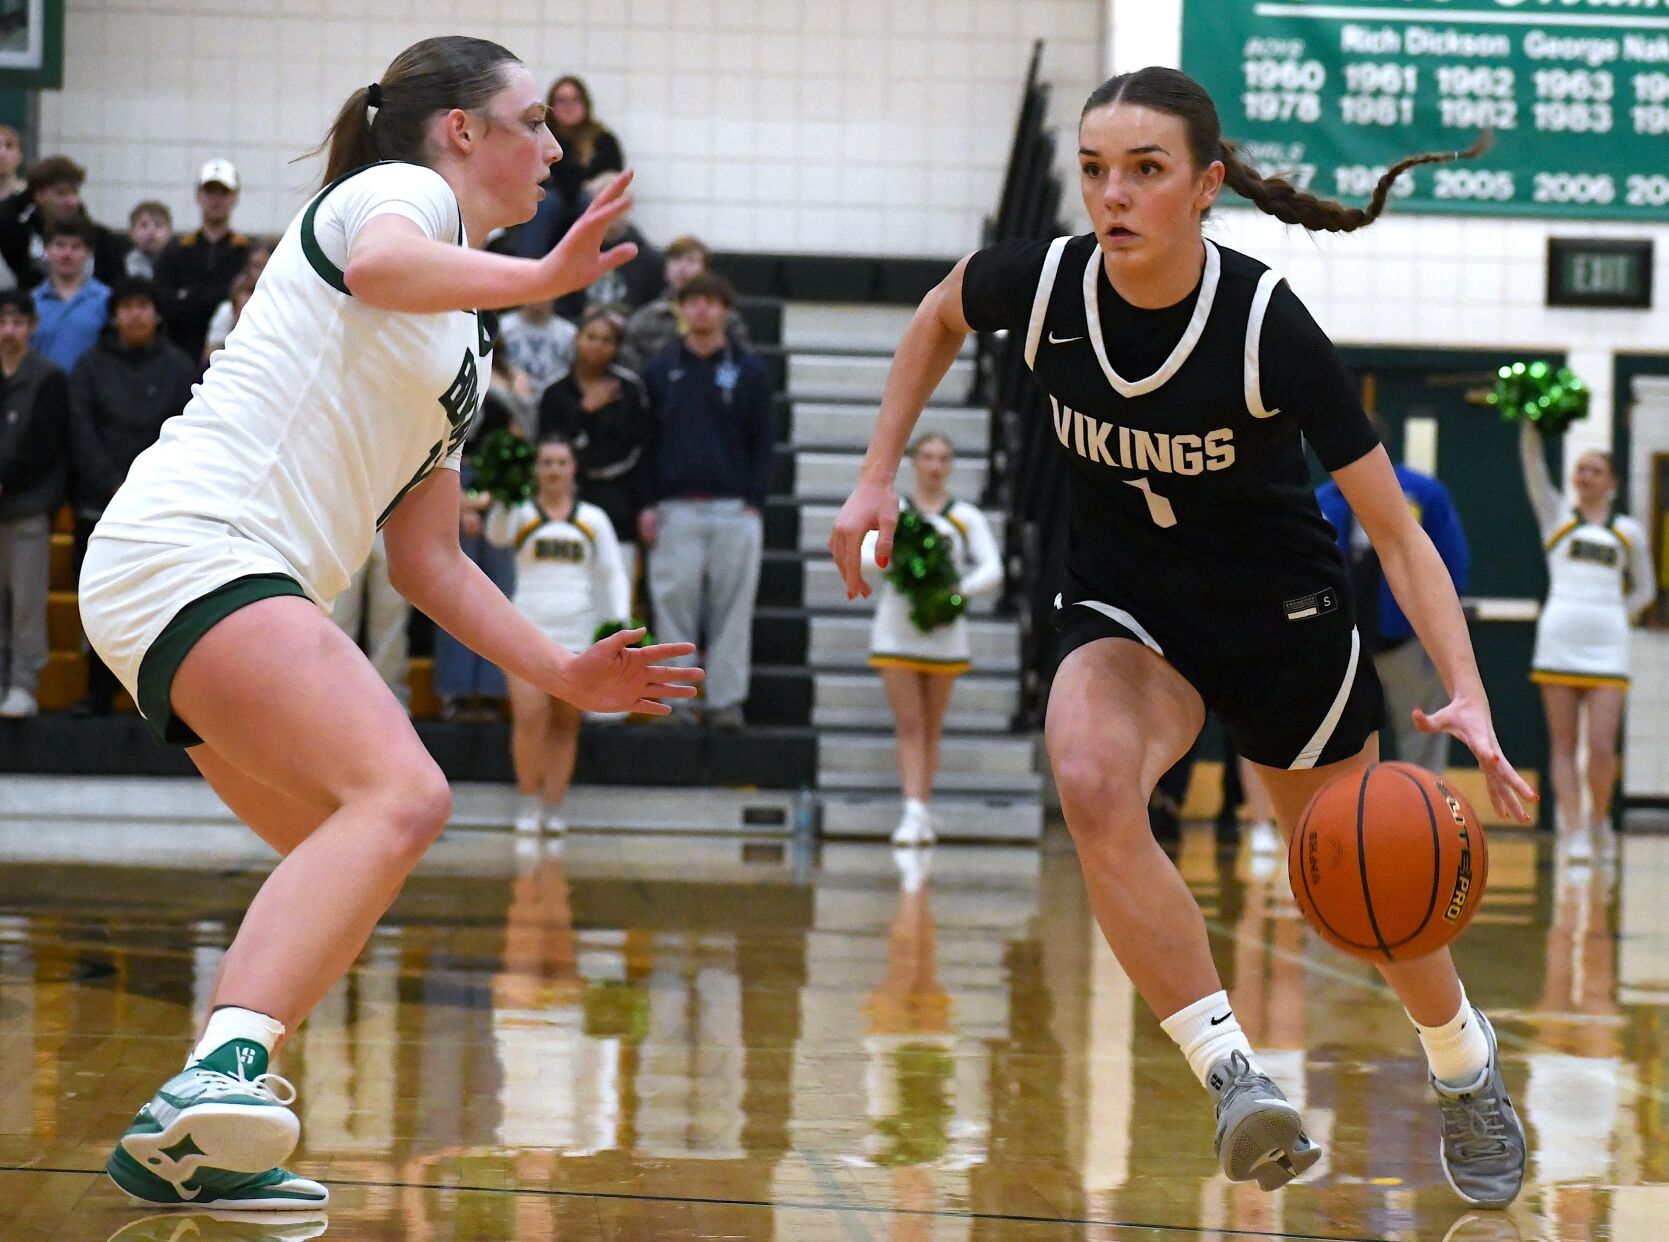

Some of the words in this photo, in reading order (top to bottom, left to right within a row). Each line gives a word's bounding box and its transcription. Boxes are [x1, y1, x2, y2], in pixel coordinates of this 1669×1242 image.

[1341, 24, 1400, 53] Rich
[1405, 26, 1510, 57] Dickson
[1524, 30, 1619, 66] George
[1243, 60, 1326, 91] 1960
[1345, 63, 1417, 94] 1961
[1437, 66, 1515, 97] 1962
[1533, 69, 1614, 101] 1963
[1434, 168, 1515, 199] 2005
[1534, 172, 1615, 204] 2006
[1050, 394, 1235, 476] VIKINGS
[1122, 477, 1177, 528] 1
[1323, 596, 1331, 607] S
